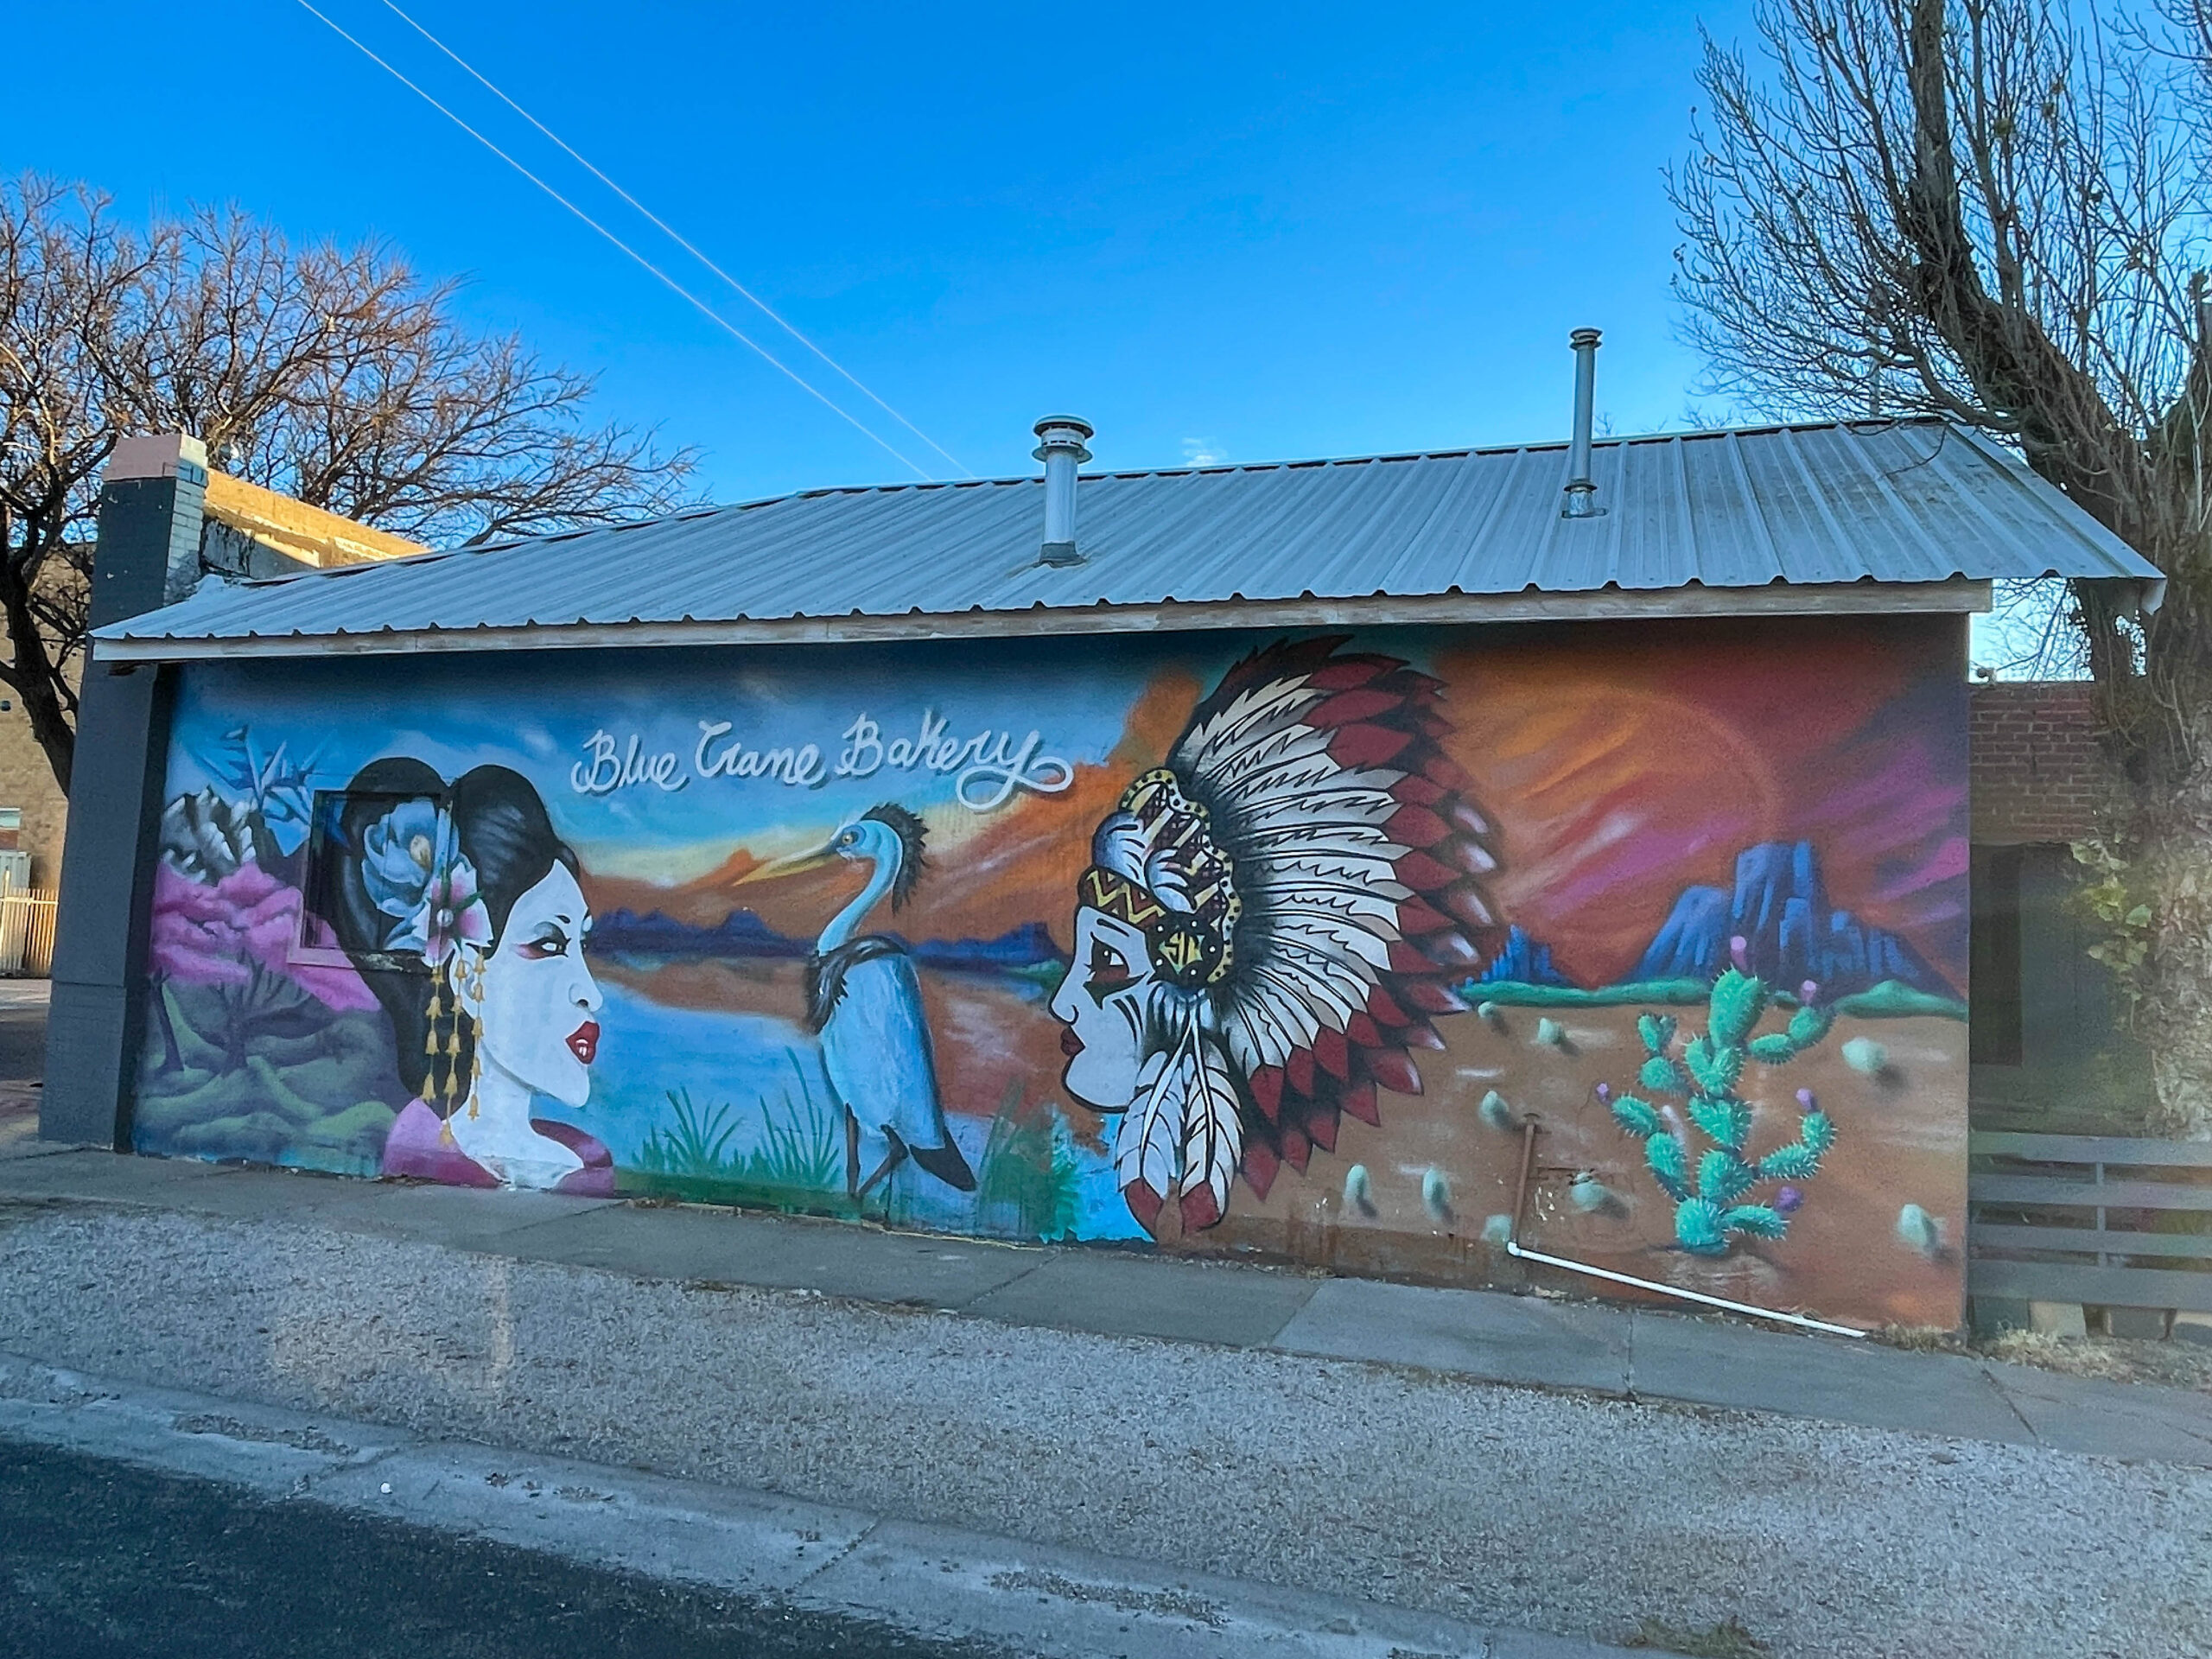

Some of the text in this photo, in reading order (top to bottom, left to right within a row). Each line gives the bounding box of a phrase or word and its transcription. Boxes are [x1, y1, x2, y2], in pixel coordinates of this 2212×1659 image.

[571, 708, 1073, 811] Blue Crane Bakery
